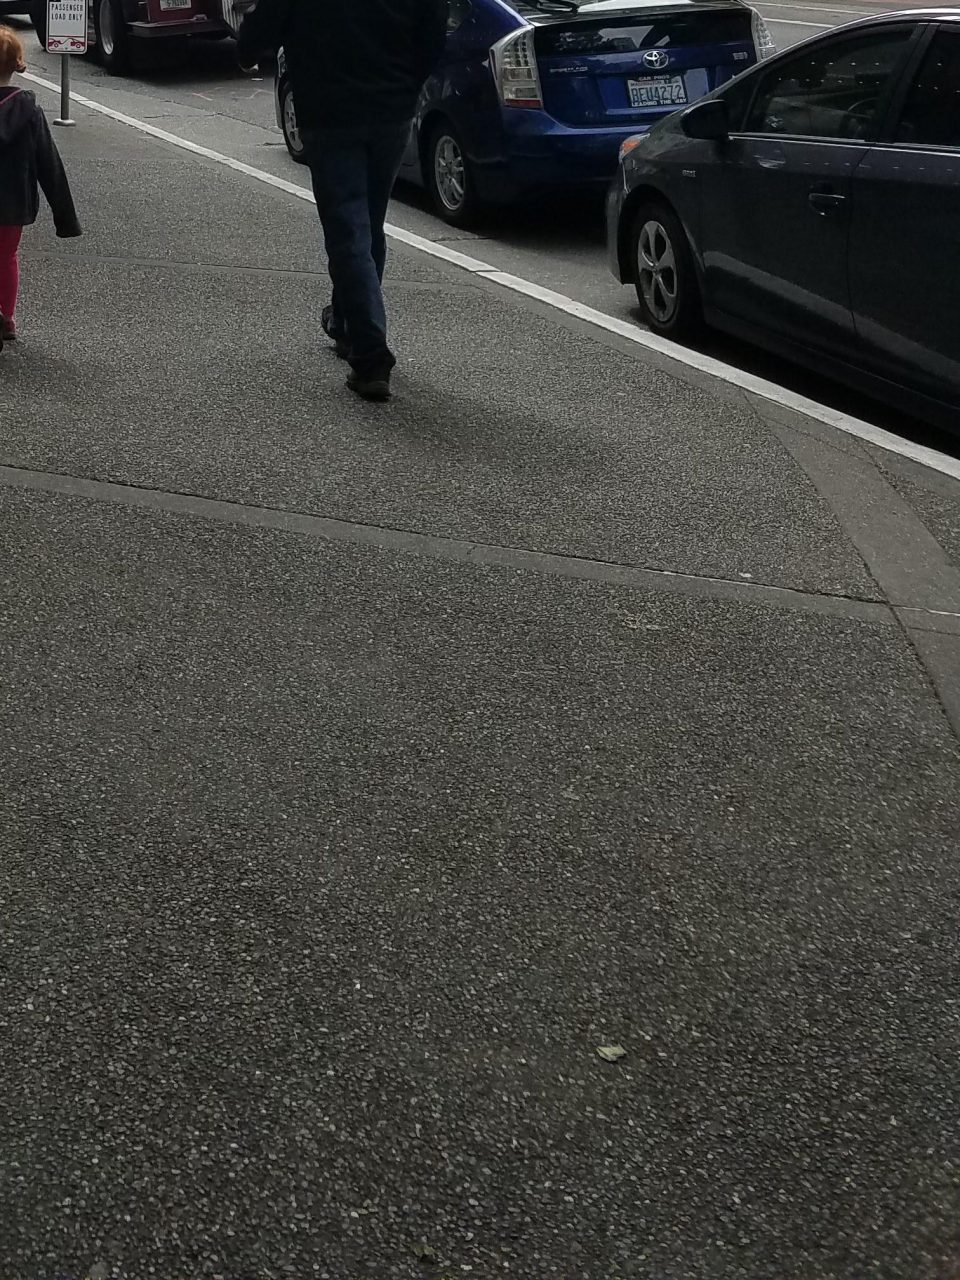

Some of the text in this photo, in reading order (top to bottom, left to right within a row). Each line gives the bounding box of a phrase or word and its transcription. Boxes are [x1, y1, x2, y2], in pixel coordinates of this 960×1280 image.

[51, 3, 84, 12] PASSENGER
[51, 13, 83, 21] LOAD ONLY
